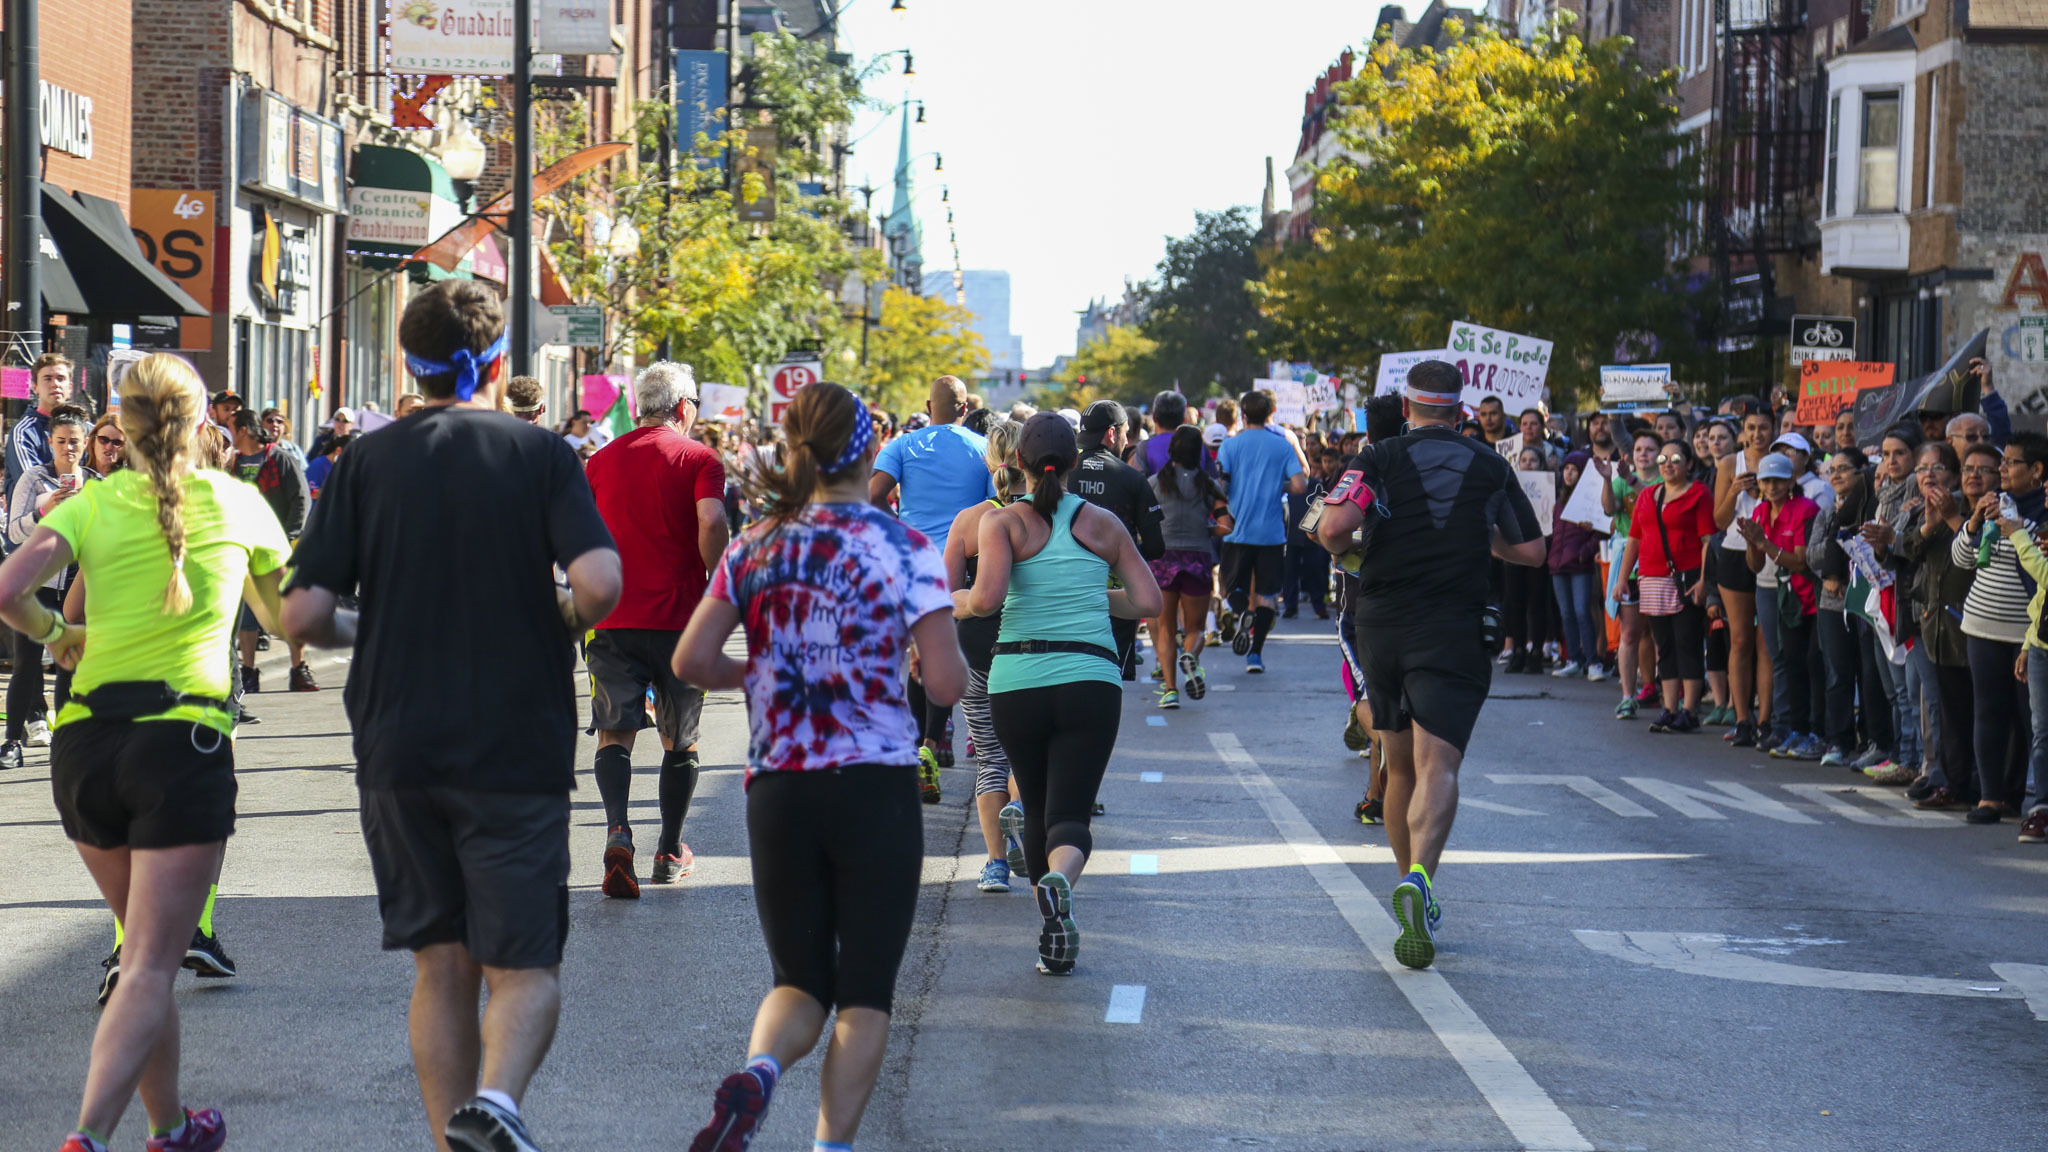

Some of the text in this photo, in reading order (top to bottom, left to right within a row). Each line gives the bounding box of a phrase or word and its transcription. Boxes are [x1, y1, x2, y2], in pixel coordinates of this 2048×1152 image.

[559, 8, 596, 18] PILSEN
[396, 56, 549, 70] (312)226-06
[39, 79, 93, 160] OMALES
[173, 194, 204, 219] 4G
[360, 190, 417, 204] Centro
[352, 204, 425, 218] Botanico
[351, 218, 427, 239] Guadalupano
[1481, 331, 1502, 355] Se
[1505, 336, 1548, 366] Puede
[782, 367, 809, 390] 19
[1806, 375, 1857, 396] EMILY
[810, 597, 845, 641] my
